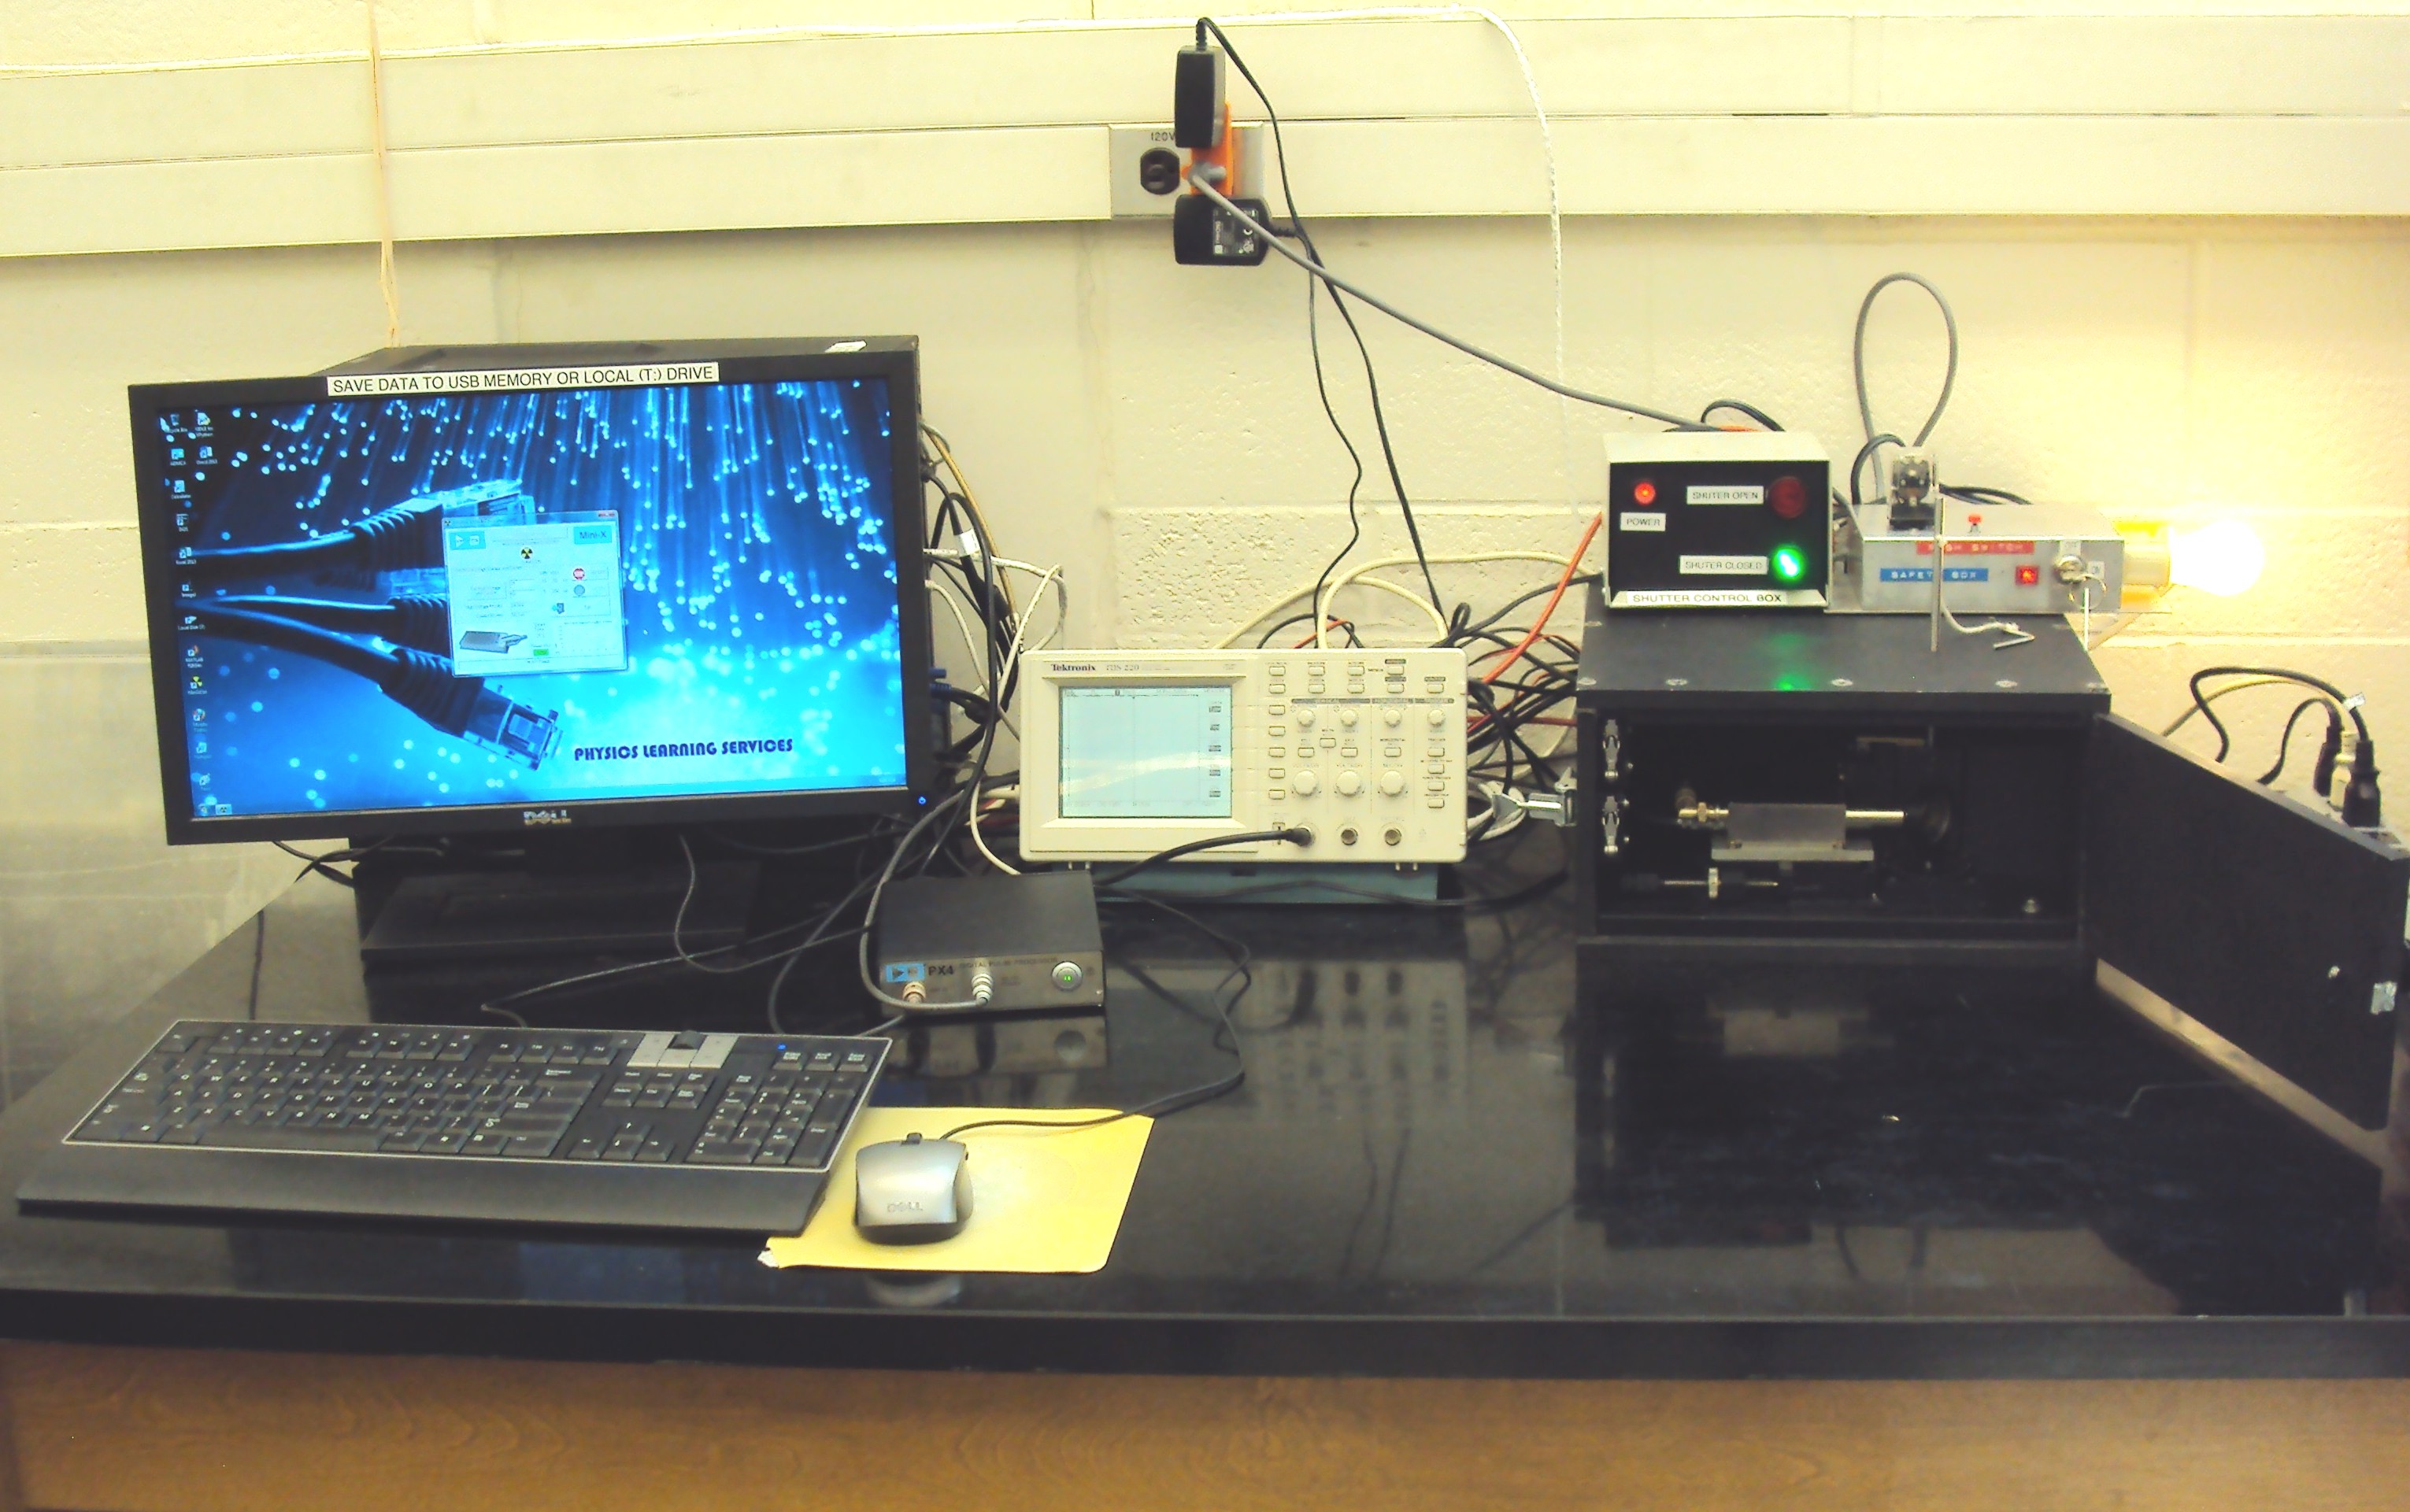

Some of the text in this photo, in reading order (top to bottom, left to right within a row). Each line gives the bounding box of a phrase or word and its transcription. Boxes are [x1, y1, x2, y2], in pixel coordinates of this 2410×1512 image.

[1151, 131, 1175, 142] 120V
[333, 366, 713, 393] SAVE DATA TO USB MEMORY OR LOCAL (T:) DRIVE
[1732, 491, 1758, 500] OPEN
[1627, 518, 1660, 527] POWER
[579, 530, 606, 540] Mini-X
[1891, 571, 1934, 579] SAFET
[1757, 593, 1782, 602] BOX
[1050, 663, 1096, 672] Tektronix
[574, 738, 793, 761] PHYSICS LEARNING SERVICES
[928, 965, 954, 977] PX4
[887, 1201, 924, 1213] DELL
